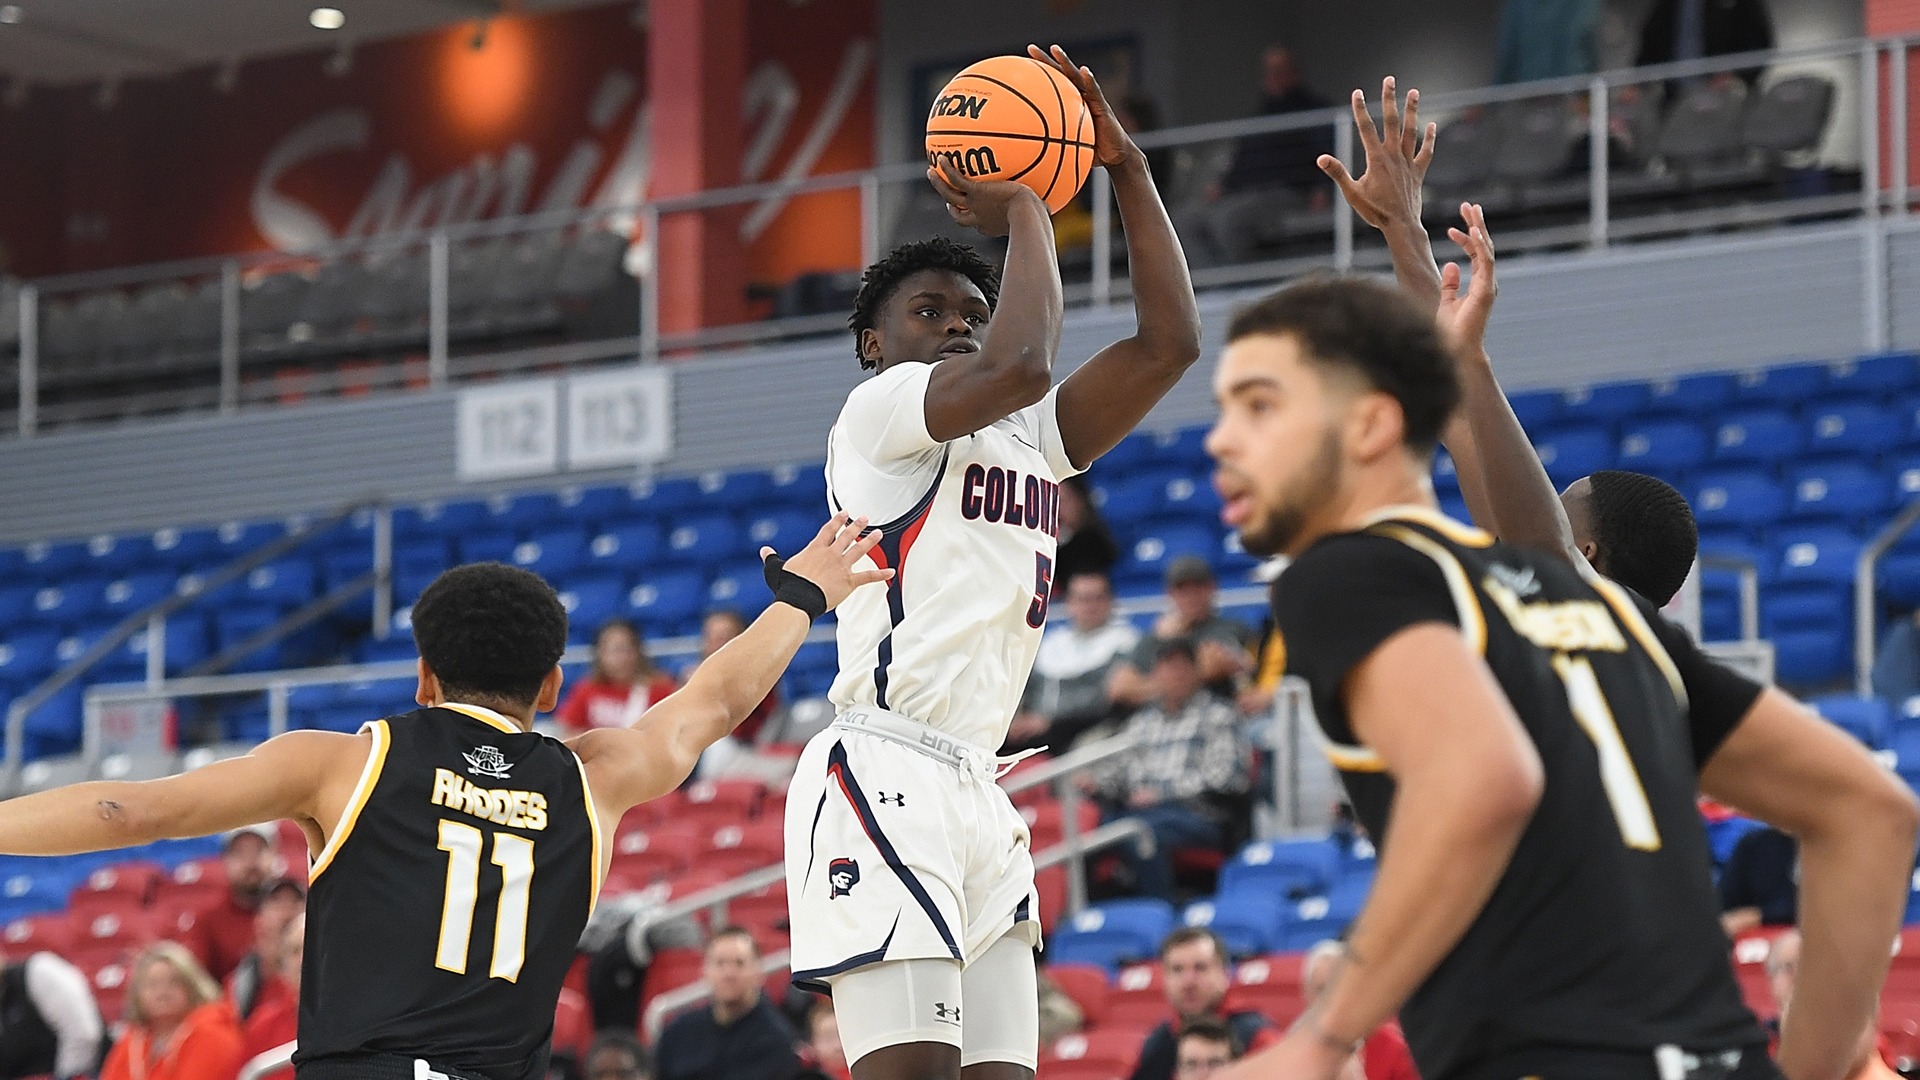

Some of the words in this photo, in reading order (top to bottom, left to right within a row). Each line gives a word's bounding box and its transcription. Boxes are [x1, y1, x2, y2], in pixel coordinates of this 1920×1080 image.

[477, 400, 541, 455] 112
[583, 389, 649, 446] 113
[1026, 550, 1052, 629] 5
[1551, 651, 1662, 852] 1
[431, 767, 548, 831] RHODES
[435, 818, 535, 984] 11
